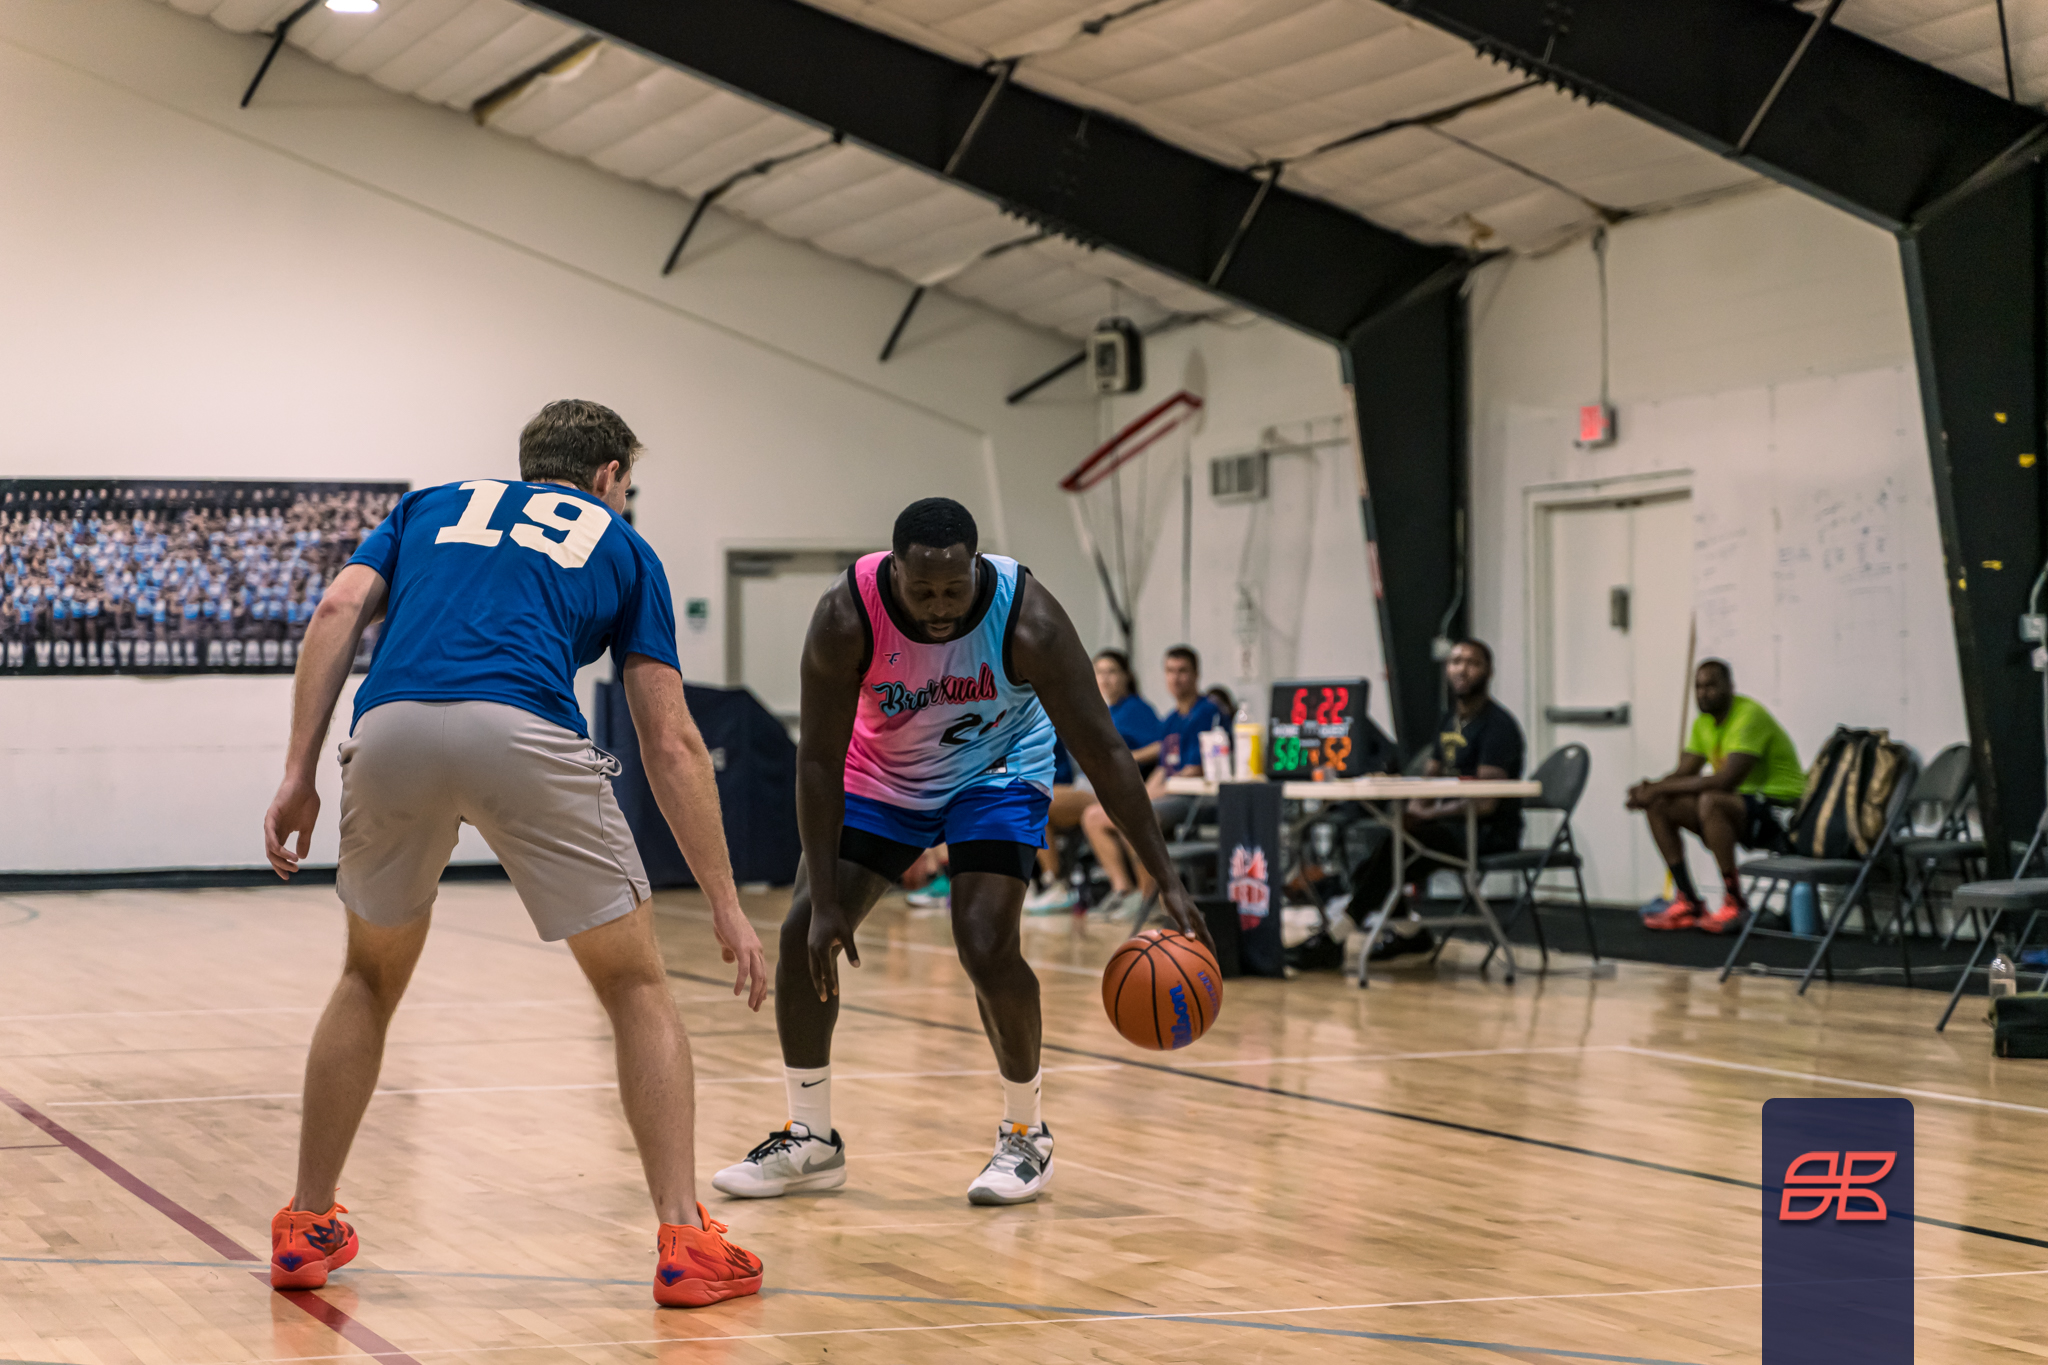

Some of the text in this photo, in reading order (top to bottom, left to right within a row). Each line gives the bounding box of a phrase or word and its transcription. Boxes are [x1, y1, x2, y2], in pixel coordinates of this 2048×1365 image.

[434, 479, 612, 569] 19
[34, 640, 199, 667] VOLLEYBALL
[1273, 736, 1300, 771] 58
